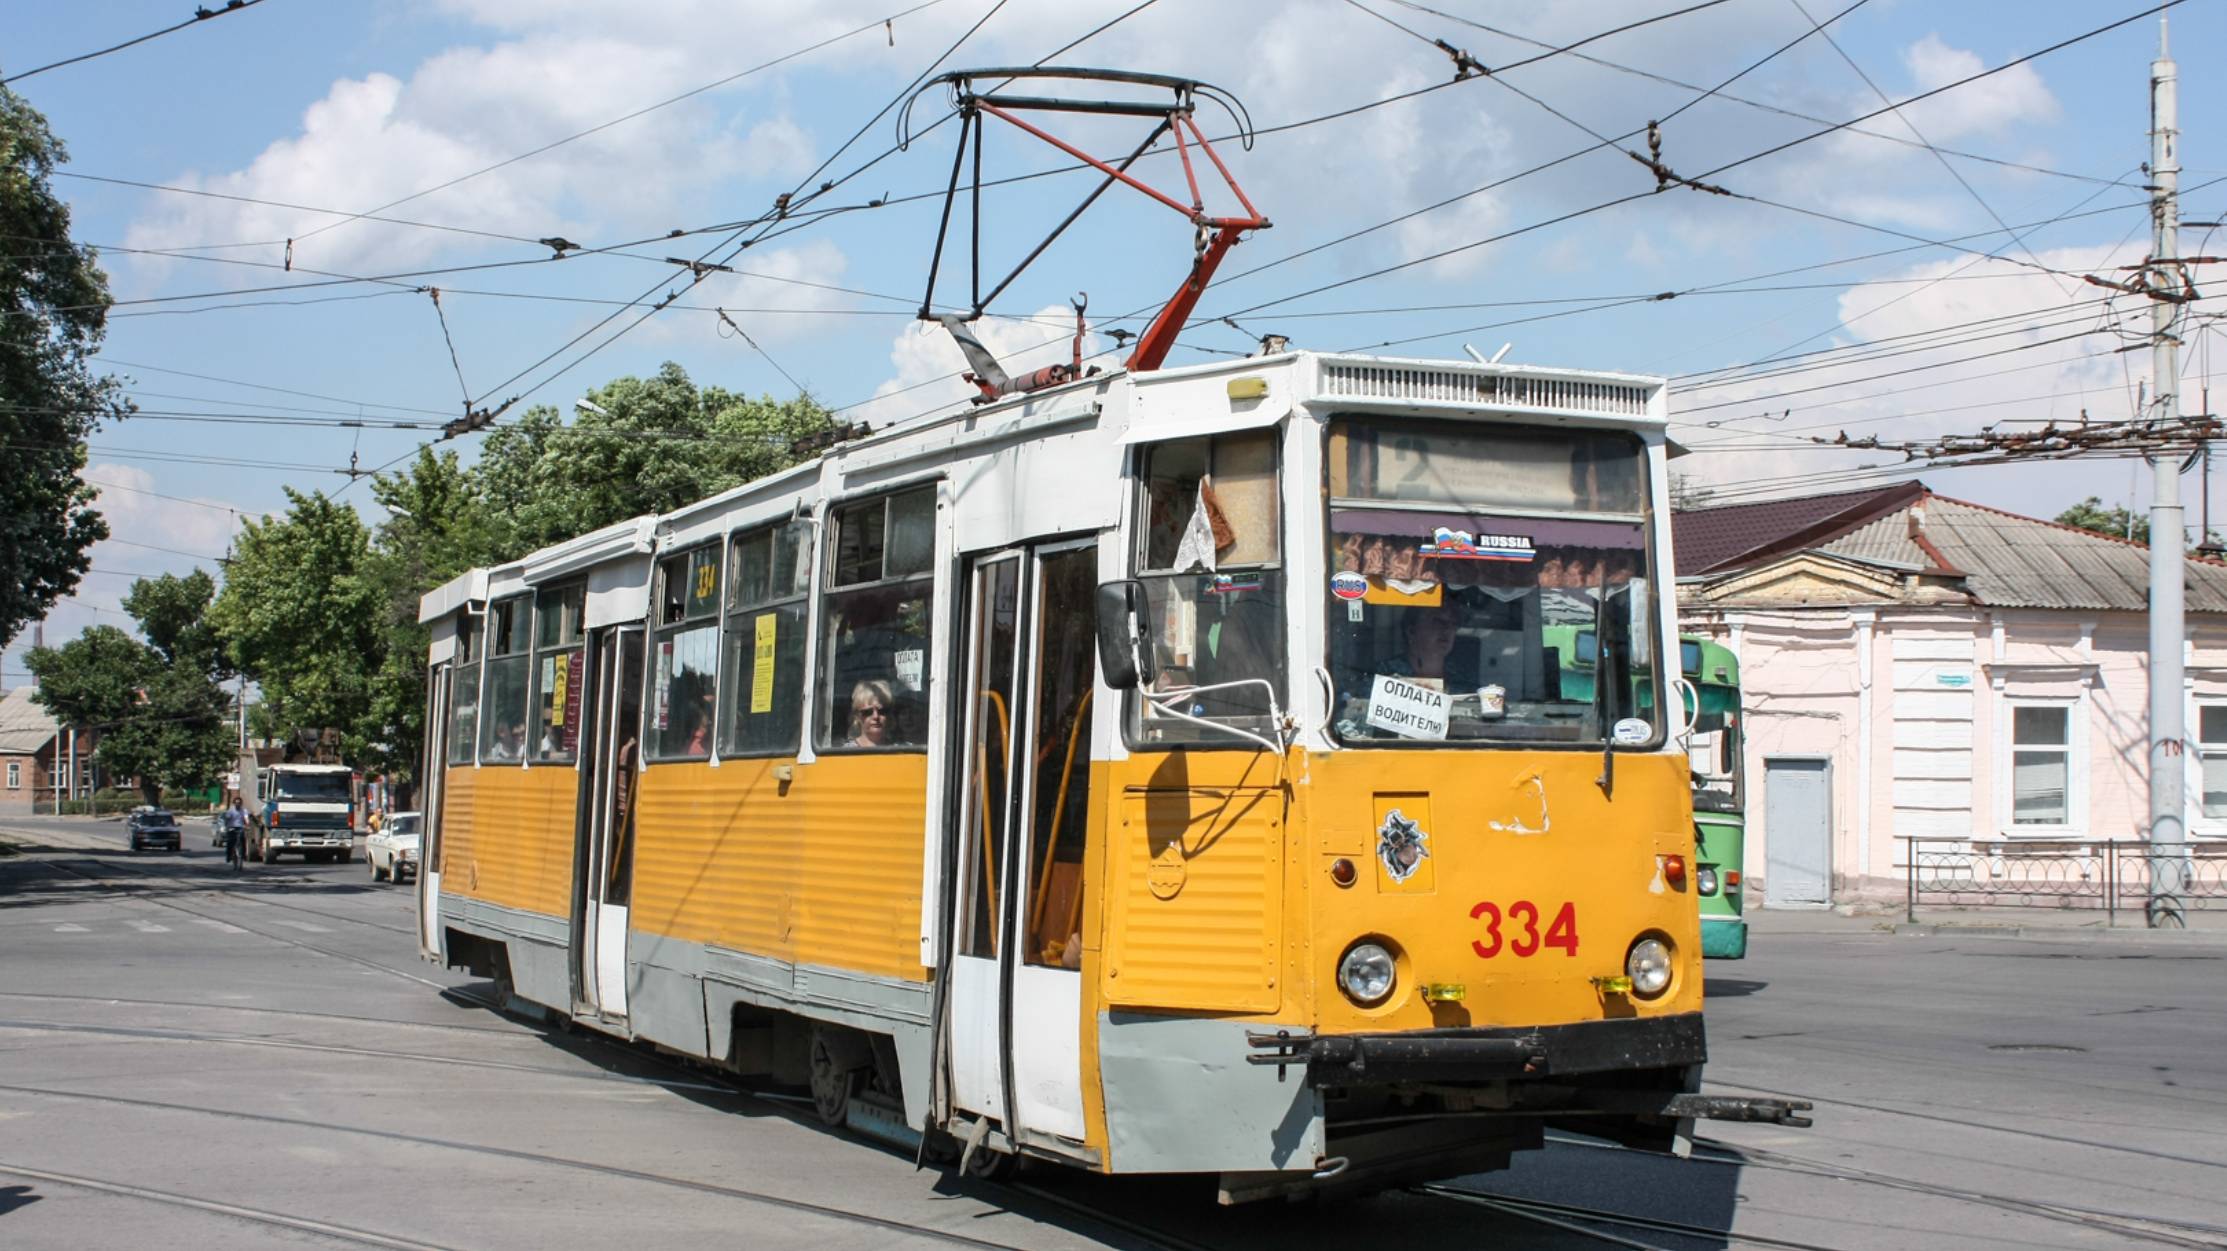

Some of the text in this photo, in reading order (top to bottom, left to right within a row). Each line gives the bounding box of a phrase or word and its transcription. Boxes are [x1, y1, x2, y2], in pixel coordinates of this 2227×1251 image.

[1395, 436, 1430, 499] 2
[1480, 534, 1531, 548] RUSSIA
[1336, 578, 1362, 592] RUS
[1384, 680, 1442, 708] ОПЛАТА
[1374, 704, 1442, 734] ВОДИТЕЛЮ
[1469, 900, 1579, 959] 334
